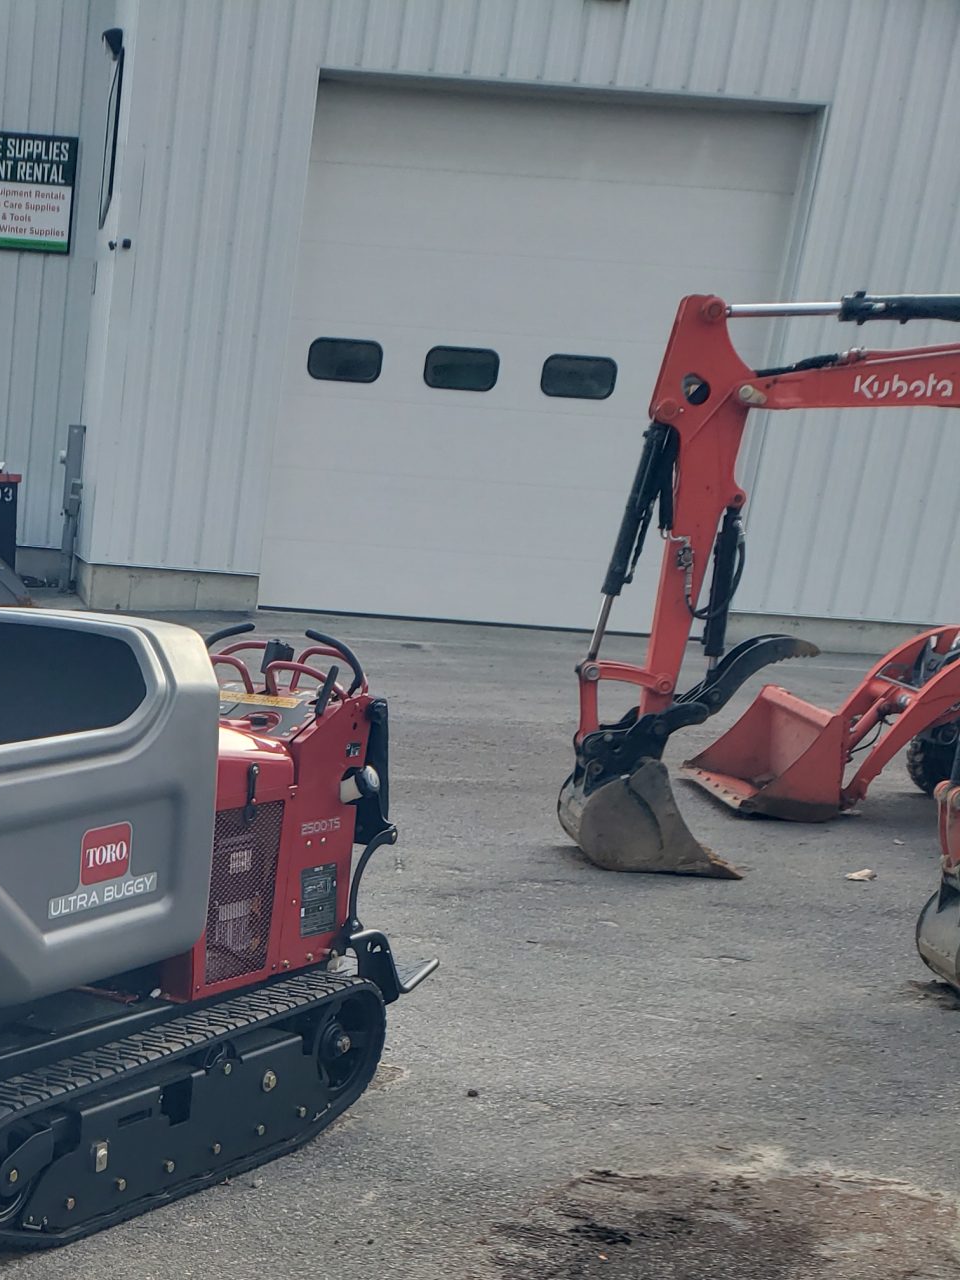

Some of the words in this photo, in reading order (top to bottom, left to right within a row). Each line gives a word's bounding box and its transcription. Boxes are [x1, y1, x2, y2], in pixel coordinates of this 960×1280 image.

[6, 137, 70, 162] SUPPLIES
[16, 161, 66, 184] RENTAL
[3, 200, 23, 210] Care
[25, 202, 61, 214] Supplies
[34, 190, 66, 201] Rentals
[10, 213, 32, 223] Tools
[0, 225, 28, 236] Winter
[29, 227, 65, 239] Supplies
[853, 373, 954, 399] Kubota
[85, 840, 127, 868] TORO
[50, 892, 99, 916] ULTRA
[103, 874, 154, 902] BUGGY
